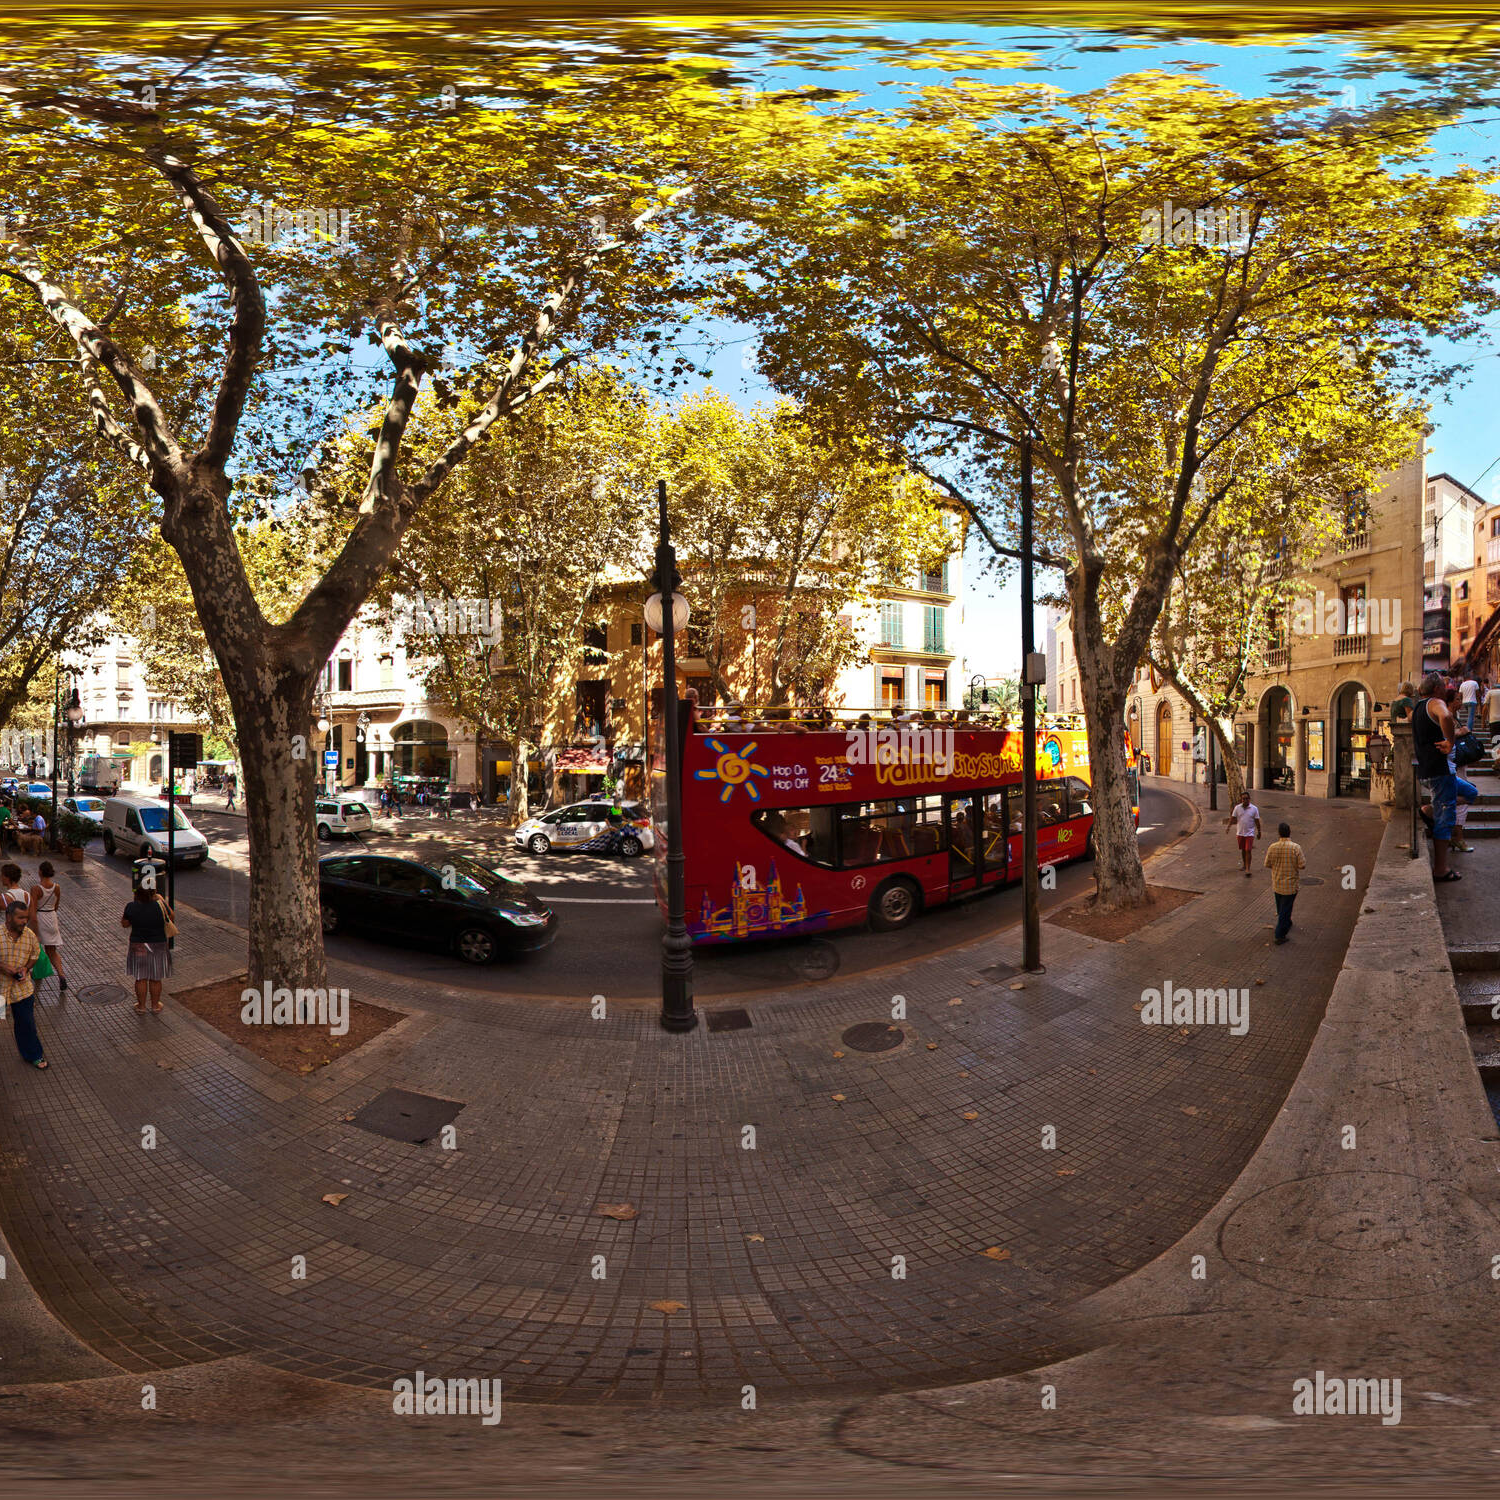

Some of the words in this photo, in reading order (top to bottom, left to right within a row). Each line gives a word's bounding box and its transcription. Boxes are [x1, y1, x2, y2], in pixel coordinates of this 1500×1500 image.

[773, 766, 792, 777] Hop
[793, 764, 807, 775] On
[820, 765, 838, 783] 24
[774, 780, 792, 791] Hop
[794, 778, 810, 789] Off
